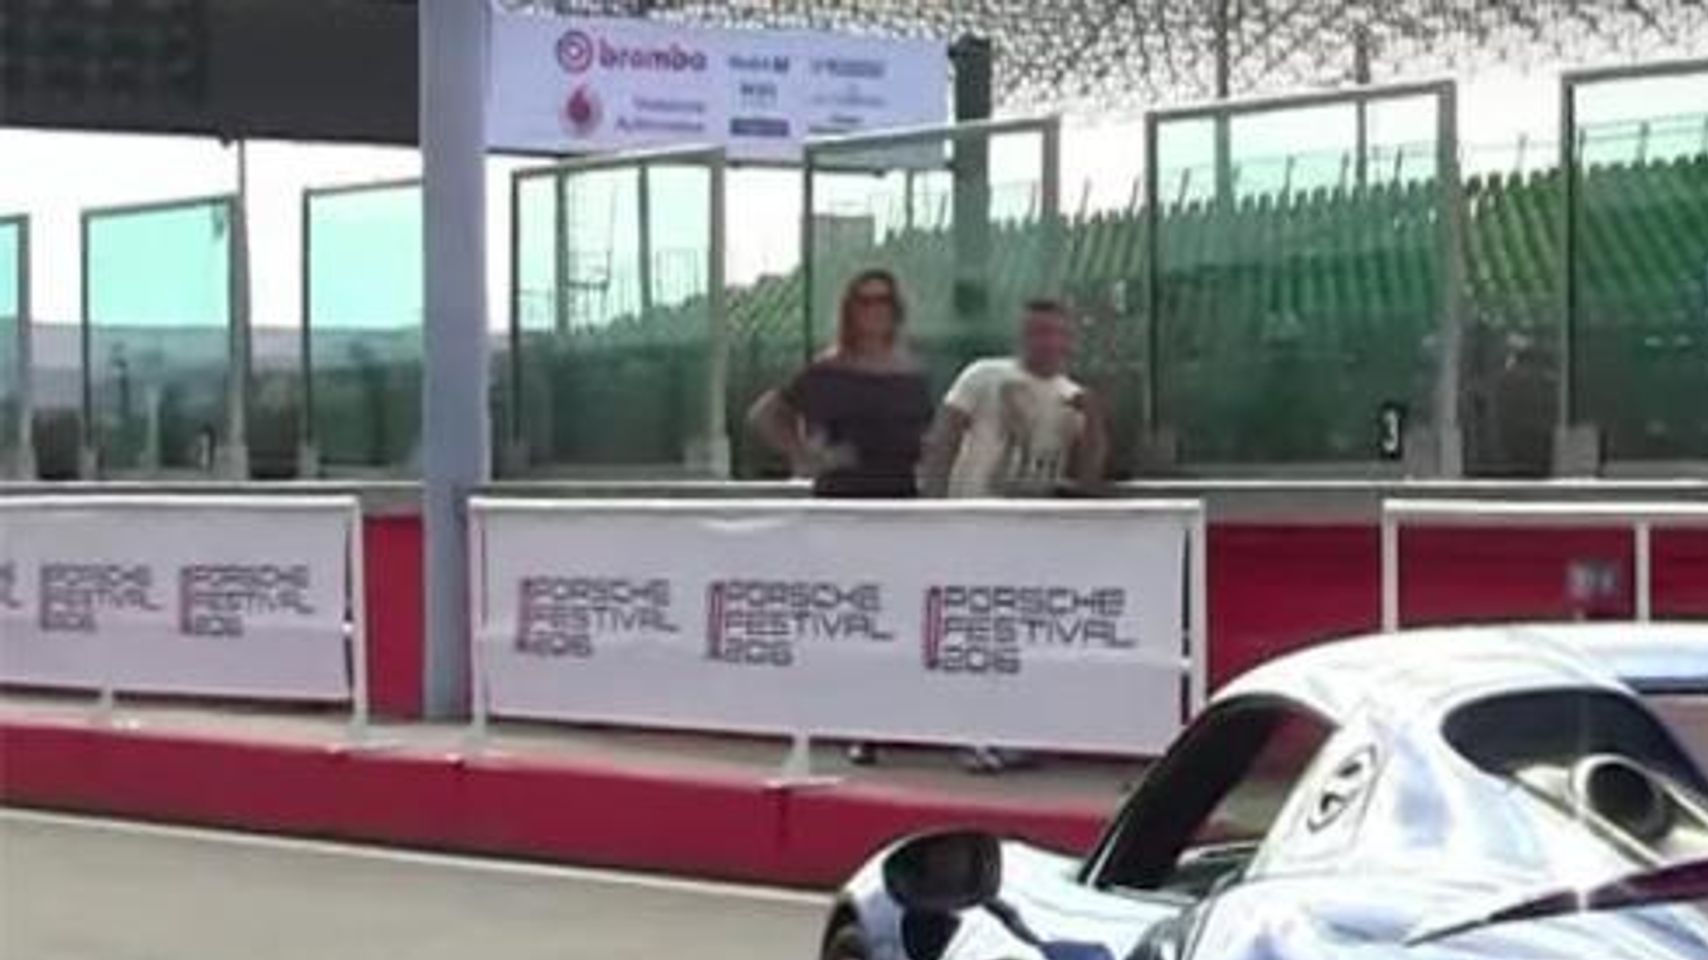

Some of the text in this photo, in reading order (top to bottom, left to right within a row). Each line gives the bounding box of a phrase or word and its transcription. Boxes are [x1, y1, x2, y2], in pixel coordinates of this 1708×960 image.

[726, 581, 881, 612] PORSCHE
[944, 585, 1125, 616] PORSCHE
[725, 609, 895, 641] FESTIVAL
[944, 615, 1140, 649] FESTIVAL
